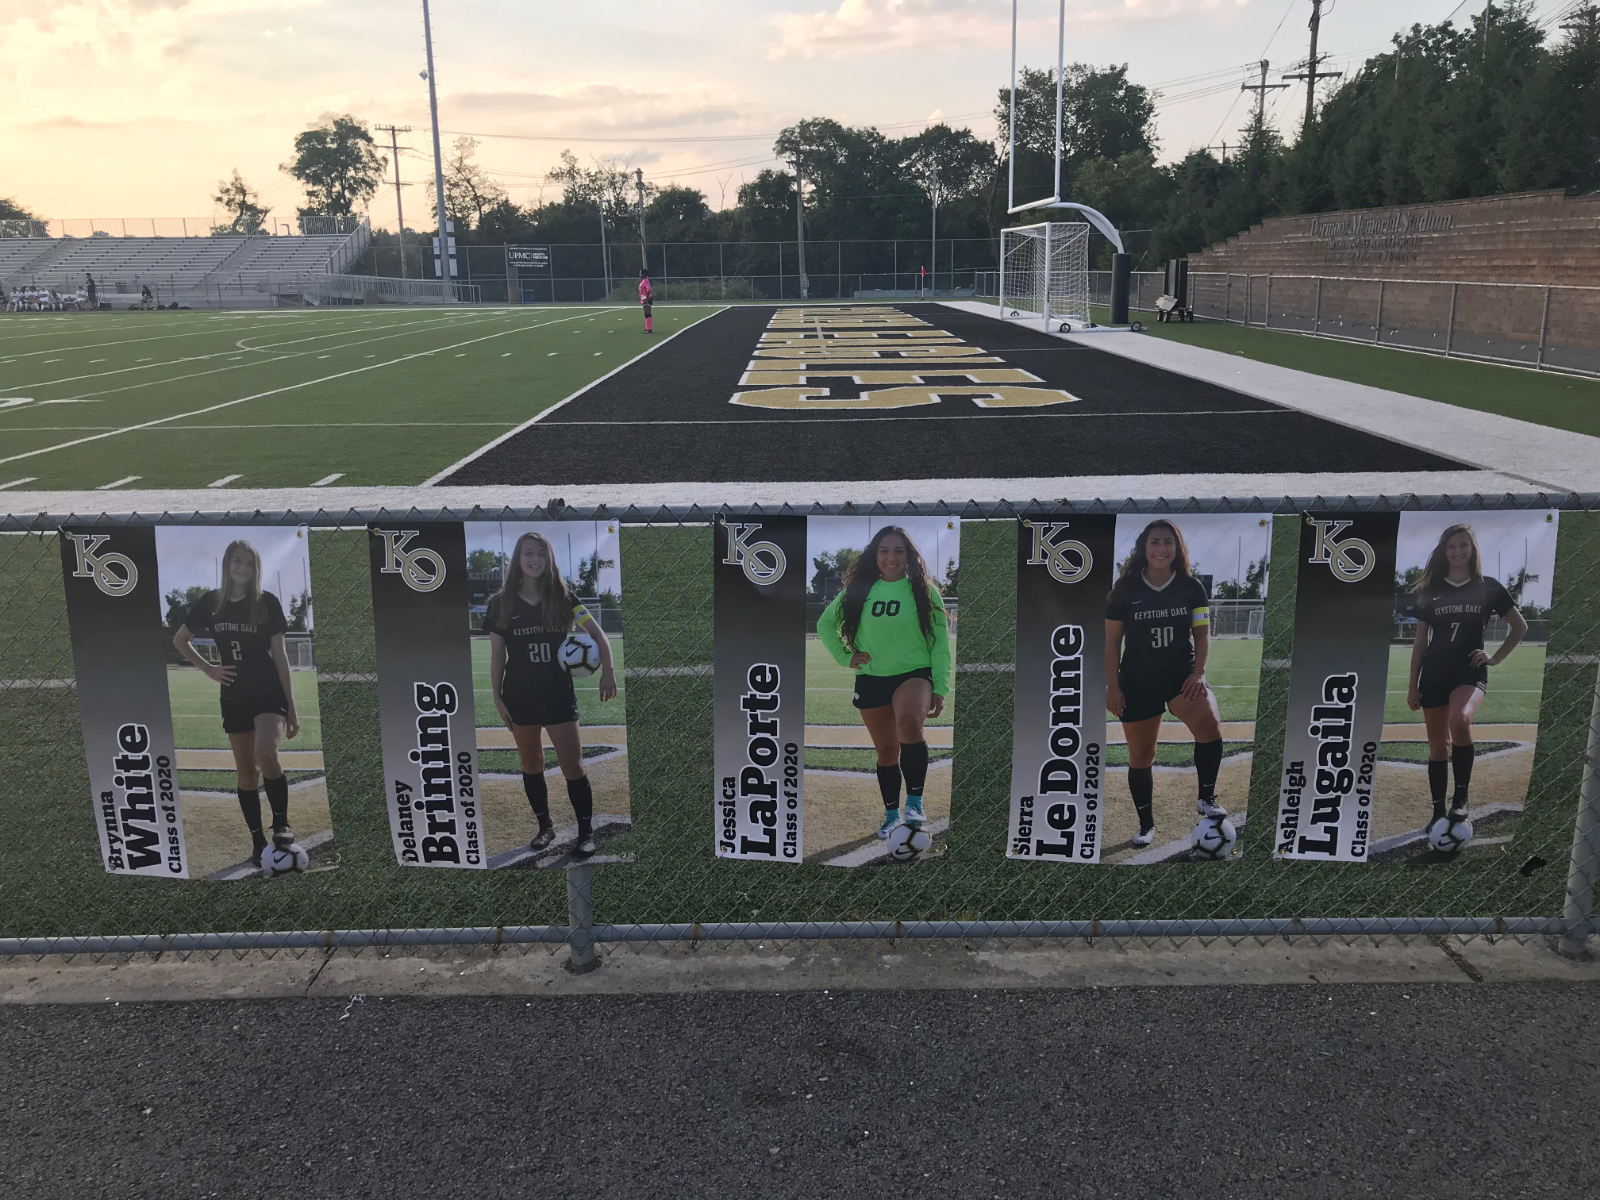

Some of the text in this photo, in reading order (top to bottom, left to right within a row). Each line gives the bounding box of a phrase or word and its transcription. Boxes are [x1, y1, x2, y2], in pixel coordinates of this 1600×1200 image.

[1310, 209, 1452, 236] Dormont Memorial Stadium
[728, 329, 1082, 409] EAGLES
[73, 534, 138, 596] KO
[380, 530, 446, 592] KO
[723, 523, 786, 585] KO
[1027, 522, 1093, 583] KO
[1309, 520, 1375, 582] KO
[513, 625, 544, 636] KEYSTONE
[871, 600, 900, 617] 00
[1134, 606, 1188, 620] KEYSTONE OAKS
[1150, 626, 1174, 648] 30
[1450, 622, 1460, 642] 7
[230, 640, 243, 661] 2
[528, 642, 552, 663] 20
[407, 682, 461, 864] Brining
[739, 663, 780, 857] LaPorte
[1035, 624, 1084, 858] Le Donne
[1298, 672, 1359, 857] Lugaila
[101, 791, 125, 869] Brynna
[113, 723, 162, 870] White
[156, 755, 182, 873] Class of 2020
[395, 780, 419, 863] Delaney
[457, 751, 480, 865] Class of 2020
[718, 776, 736, 853] Jessica
[783, 743, 799, 858] Class of 2020
[1013, 795, 1034, 856] Sierra
[1080, 742, 1100, 859] Class of 2020
[1278, 761, 1307, 854] Ashleigh
[1350, 741, 1377, 857] Class of 2020
